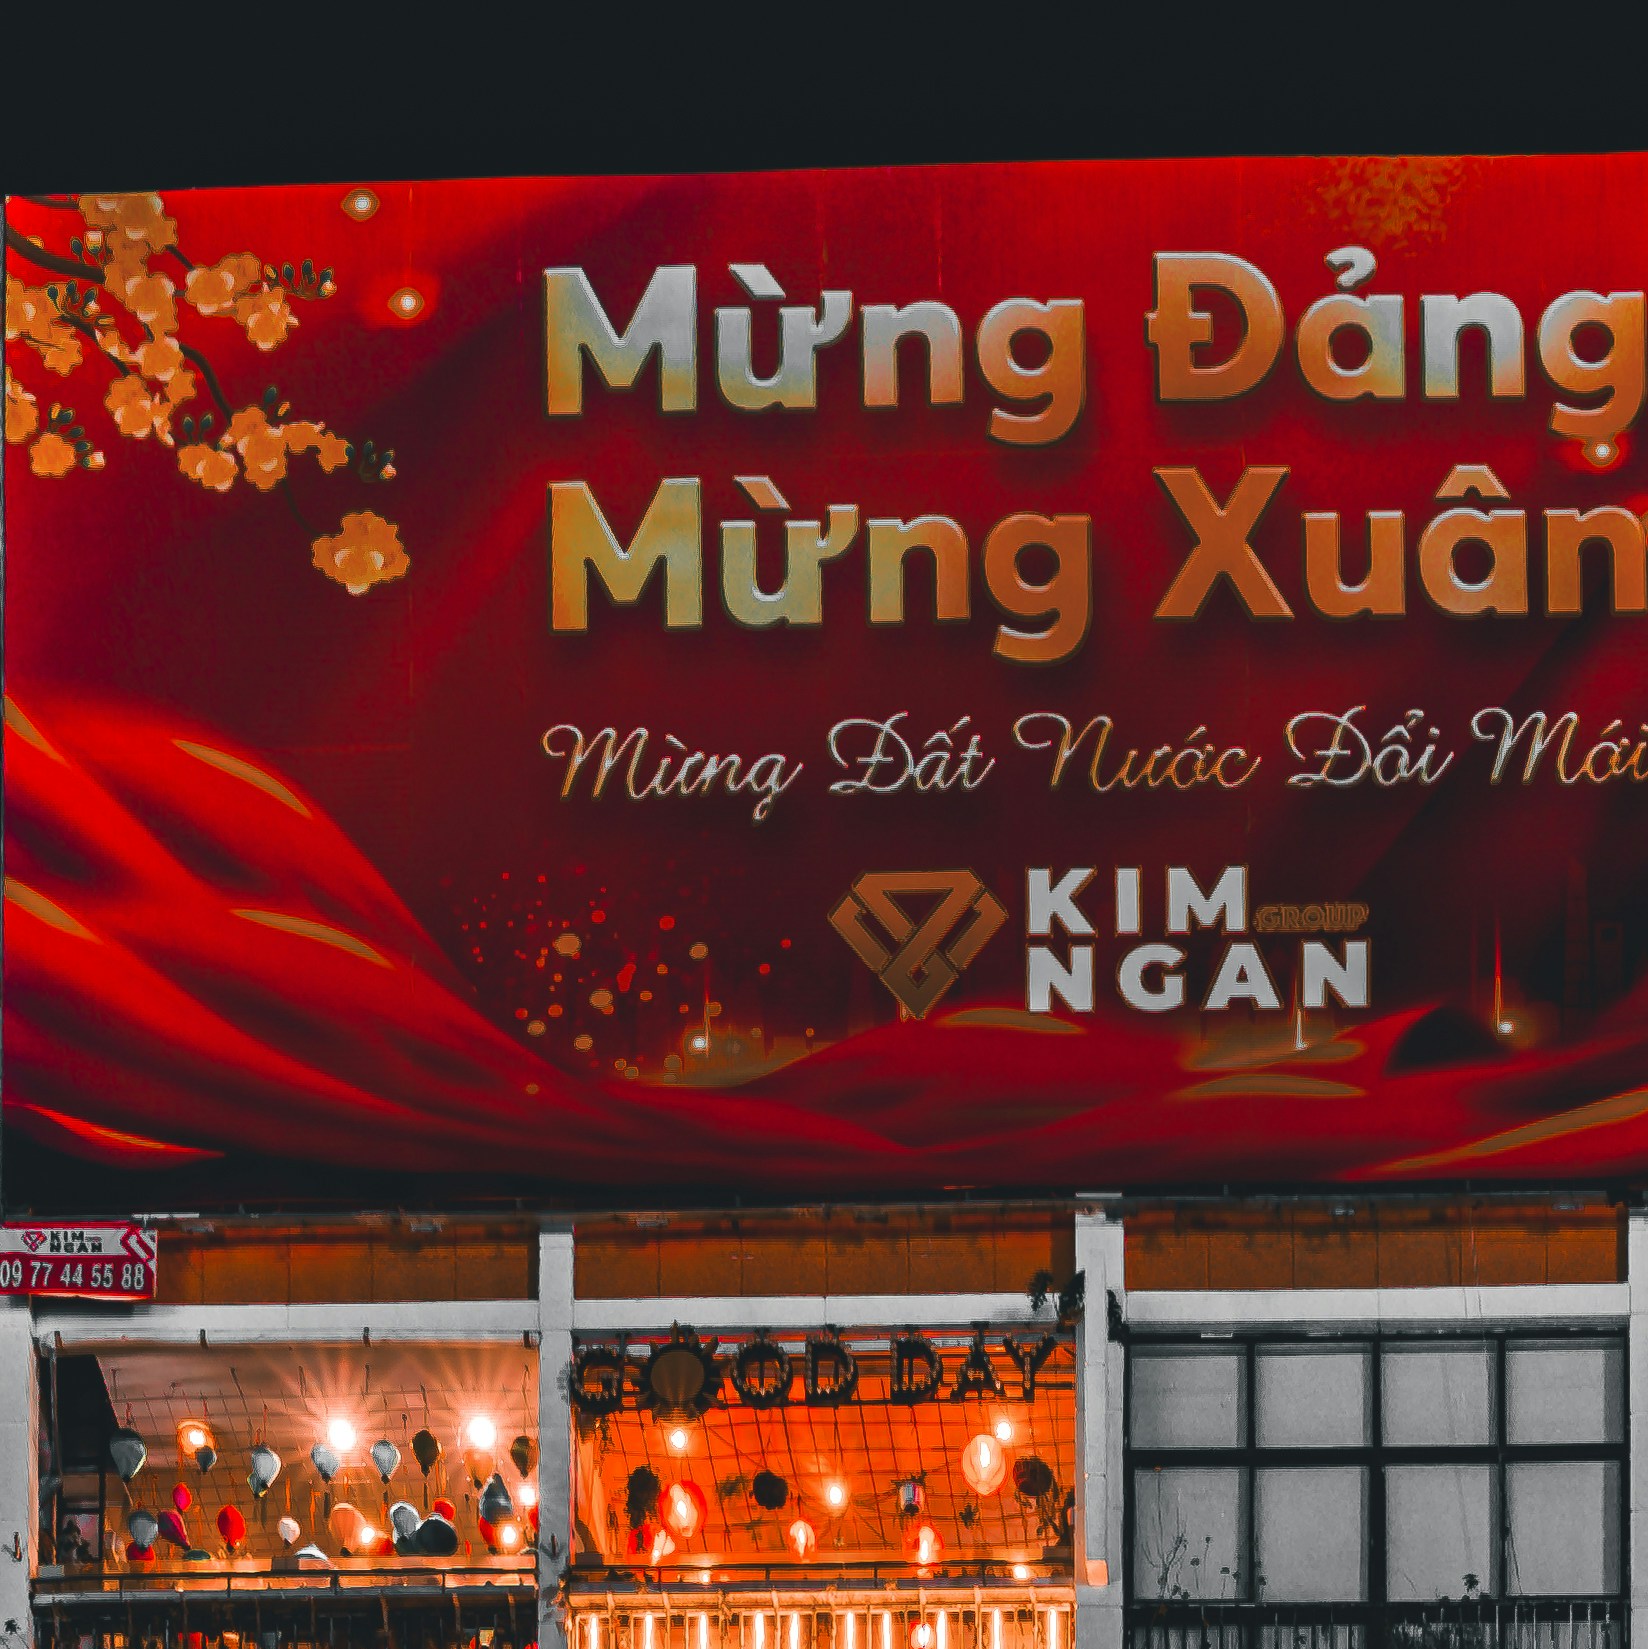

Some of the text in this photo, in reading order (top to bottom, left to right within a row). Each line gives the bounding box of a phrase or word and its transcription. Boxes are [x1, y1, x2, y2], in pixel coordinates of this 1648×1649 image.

[544, 247, 1648, 446] Mừng Đảng
[547, 464, 1648, 662] Mừng Xuân
[542, 720, 803, 821] Mừng
[828, 711, 995, 794] Đất
[1014, 711, 1260, 793] Nước
[1286, 706, 1454, 788] Đổi
[1025, 866, 1370, 936] KIM GROUP
[1025, 941, 1370, 1012] NGAN
[50, 1231, 84, 1242] KIM
[50, 1243, 103, 1253] NGAN
[0, 1259, 144, 1290] 09 77 44 55 88
[891, 1328, 1055, 1403] DAY
